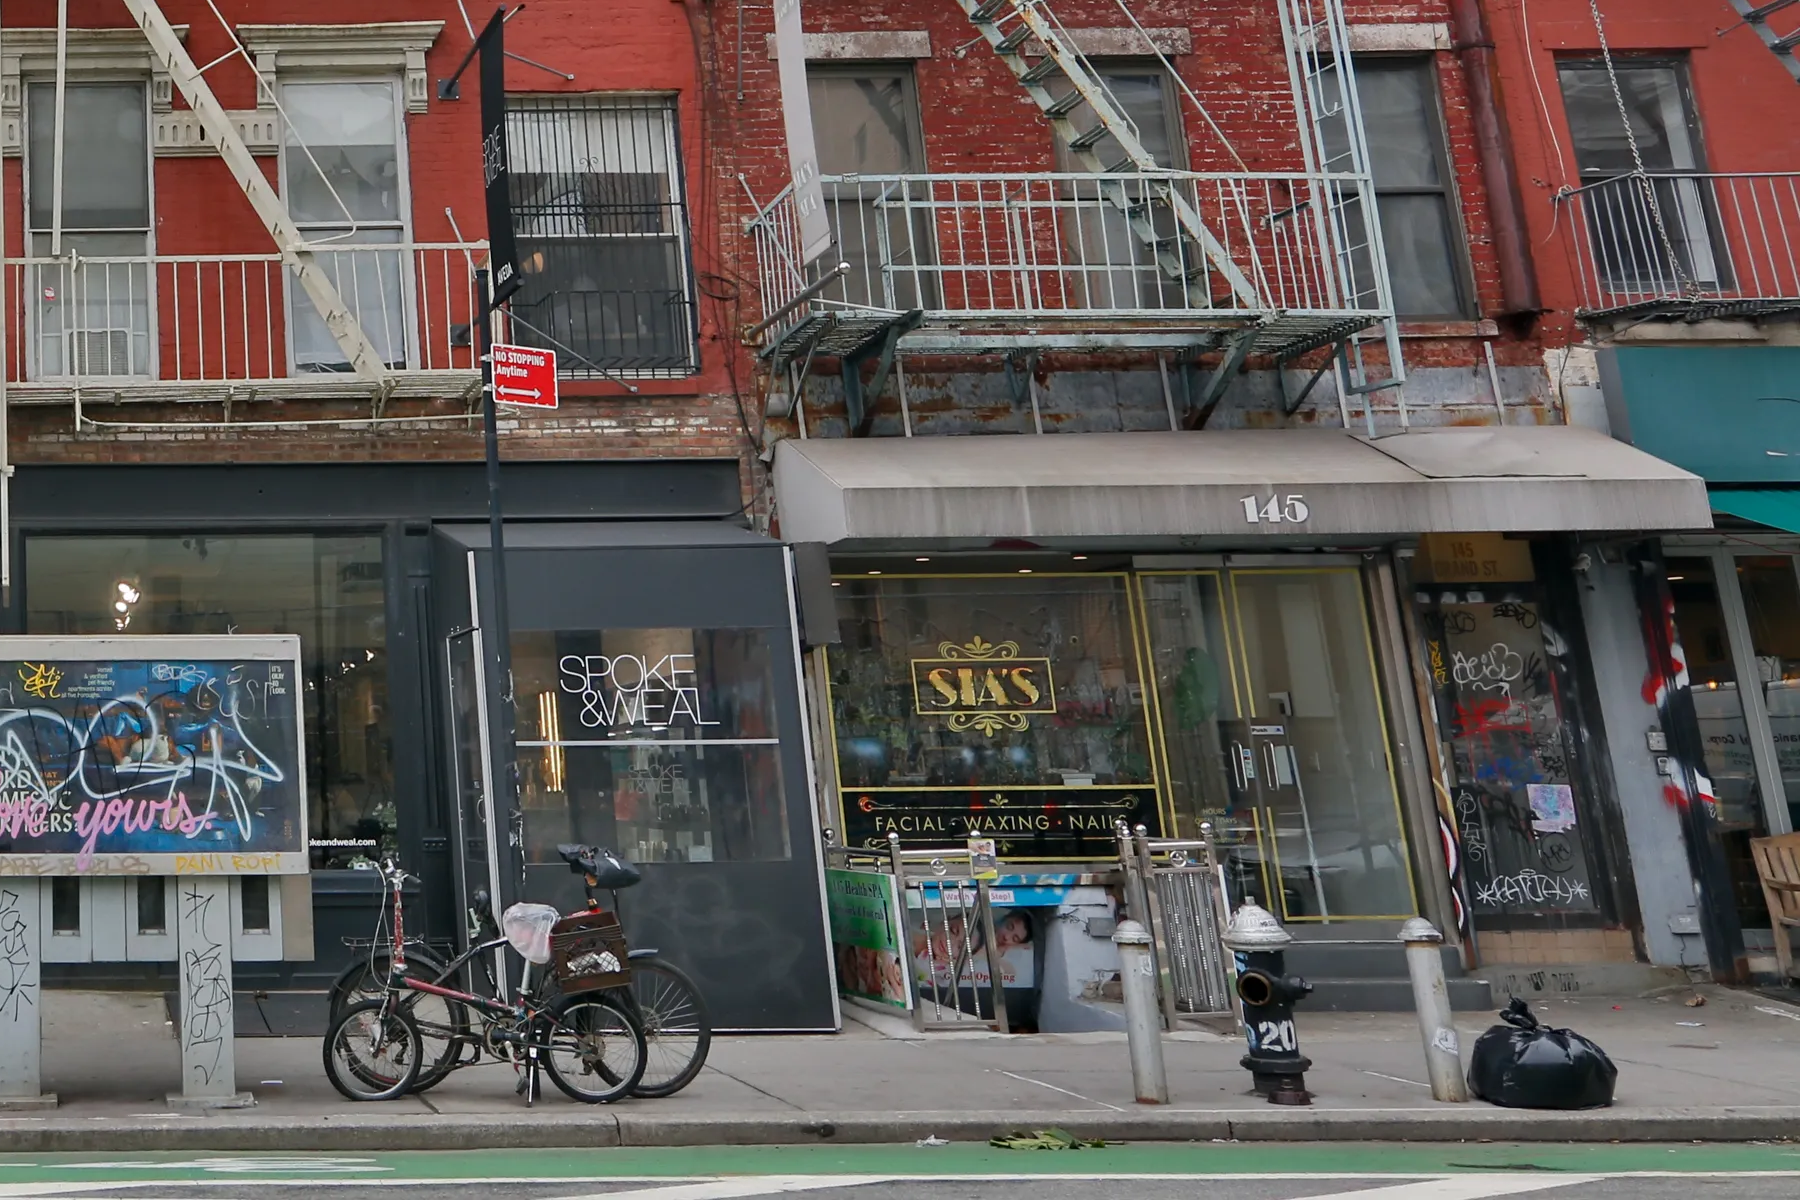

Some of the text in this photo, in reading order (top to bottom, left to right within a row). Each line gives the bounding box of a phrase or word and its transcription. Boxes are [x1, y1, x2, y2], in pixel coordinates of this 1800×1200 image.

[495, 351, 545, 367] NO STOPPING
[496, 364, 528, 378] Anytime
[1240, 494, 1308, 523] 145
[1449, 542, 1475, 558] 145
[559, 654, 694, 693] SPOKE
[928, 667, 1040, 707] SIA'S
[580, 688, 720, 727] &WEAL
[628, 764, 683, 779] SPOKE
[875, 816, 945, 832] FACIAL
[963, 815, 1050, 830] WAXING
[991, 892, 1011, 901] Step!
[1258, 1019, 1299, 1052] 20
